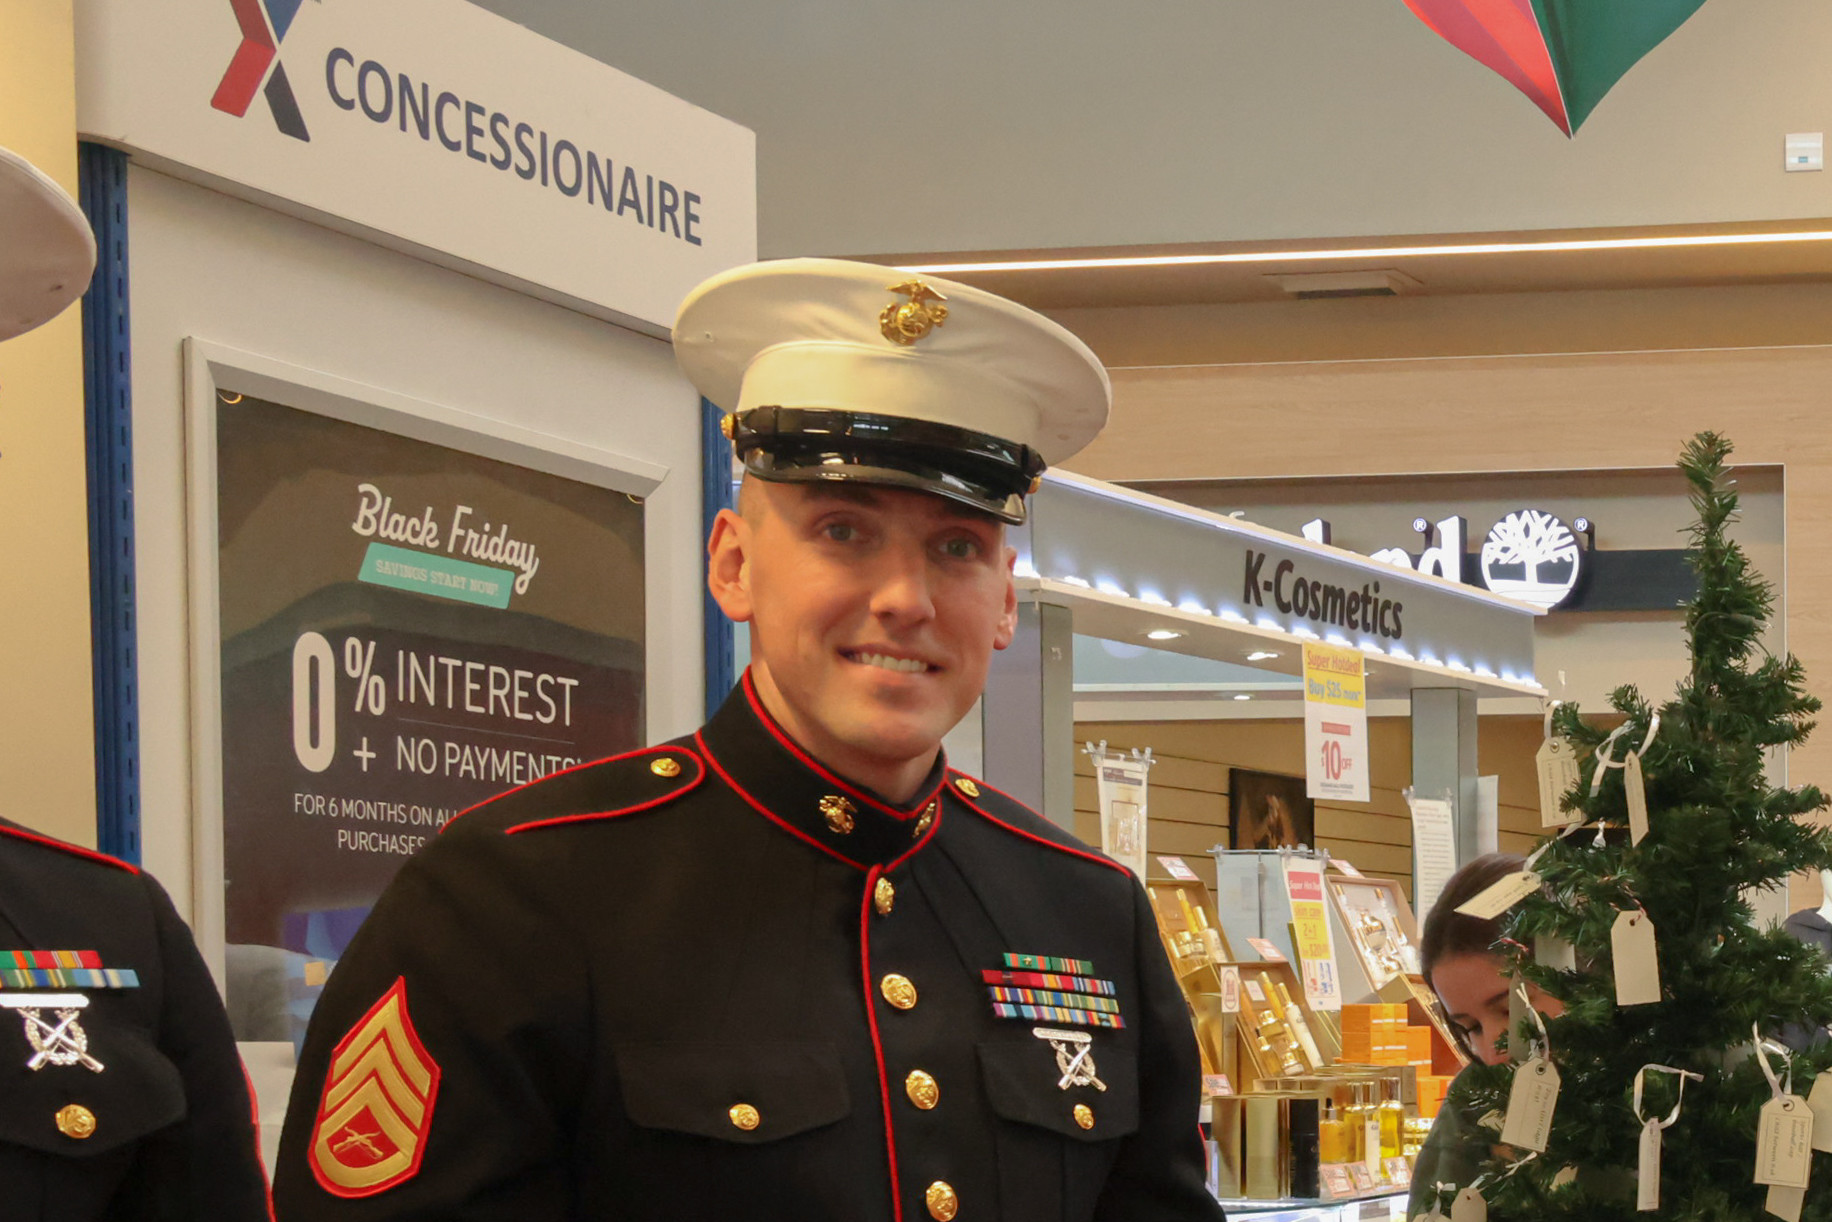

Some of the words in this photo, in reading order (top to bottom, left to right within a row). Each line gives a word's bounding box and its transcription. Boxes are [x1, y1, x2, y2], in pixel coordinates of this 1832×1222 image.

[326, 47, 702, 246] CONCESSIONAIRE
[352, 483, 440, 548] Black
[447, 504, 539, 594] Friday
[375, 559, 428, 583] SAVINGS
[430, 571, 467, 590] START
[1243, 549, 1403, 640] K-Cosmetics
[293, 631, 386, 773] 0%
[398, 649, 579, 726] INTEREST
[396, 735, 437, 775] NO
[294, 793, 326, 817] FOR
[328, 797, 339, 818] 6
[341, 798, 408, 825] MONTHS
[409, 804, 433, 827] ON
